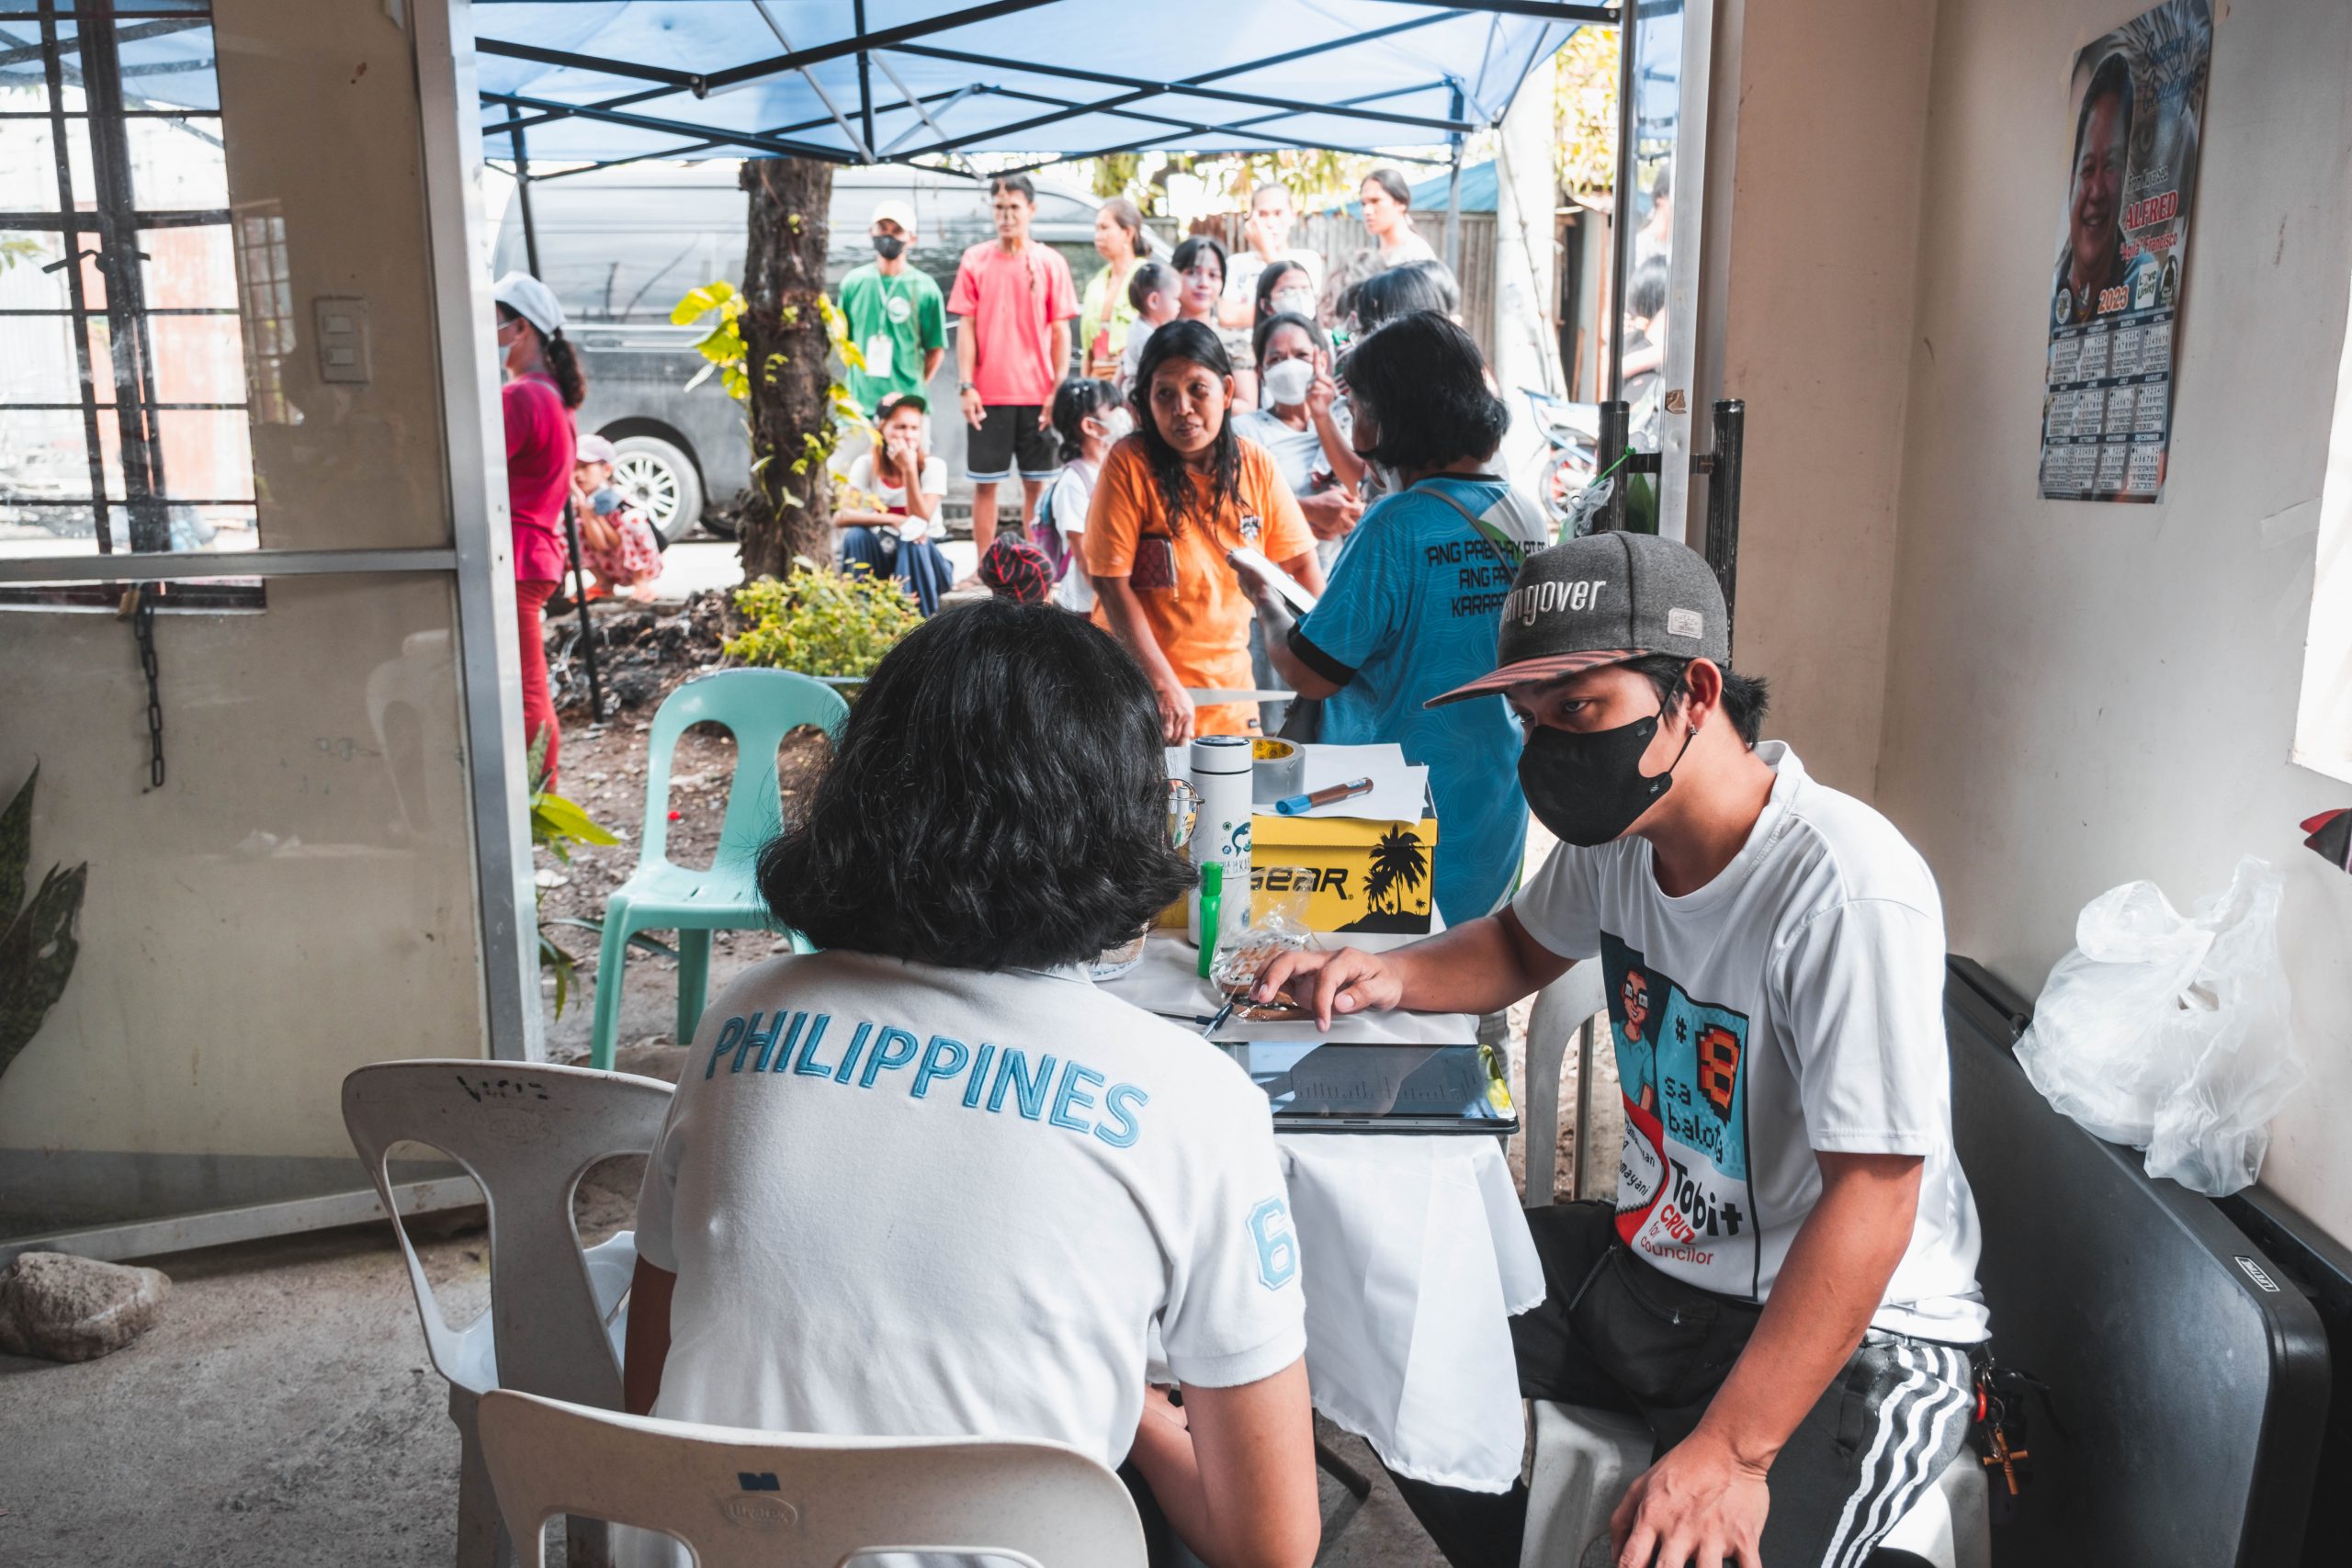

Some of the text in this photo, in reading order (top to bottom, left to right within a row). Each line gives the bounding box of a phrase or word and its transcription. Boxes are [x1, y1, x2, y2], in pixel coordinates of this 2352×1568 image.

[2124, 189, 2178, 231] ALFRED
[2144, 232, 2178, 254] Francisco
[2098, 284, 2130, 314] 2023
[2134, 433, 2160, 441] DECEMBER
[1459, 567, 1490, 590] ANG
[1452, 592, 1508, 617] KARAPA
[1503, 581, 1606, 626] angover
[706, 1010, 1149, 1149] PHILIPPINES
[1665, 1077, 1691, 1106] sa
[1668, 1102, 1723, 1164] balota
[1668, 1156, 1744, 1236] Tobit
[1648, 1221, 1661, 1238] for
[1660, 1203, 1696, 1245] CRUZ
[1245, 1195, 1296, 1291] 6
[1640, 1236, 1714, 1266] councilor
